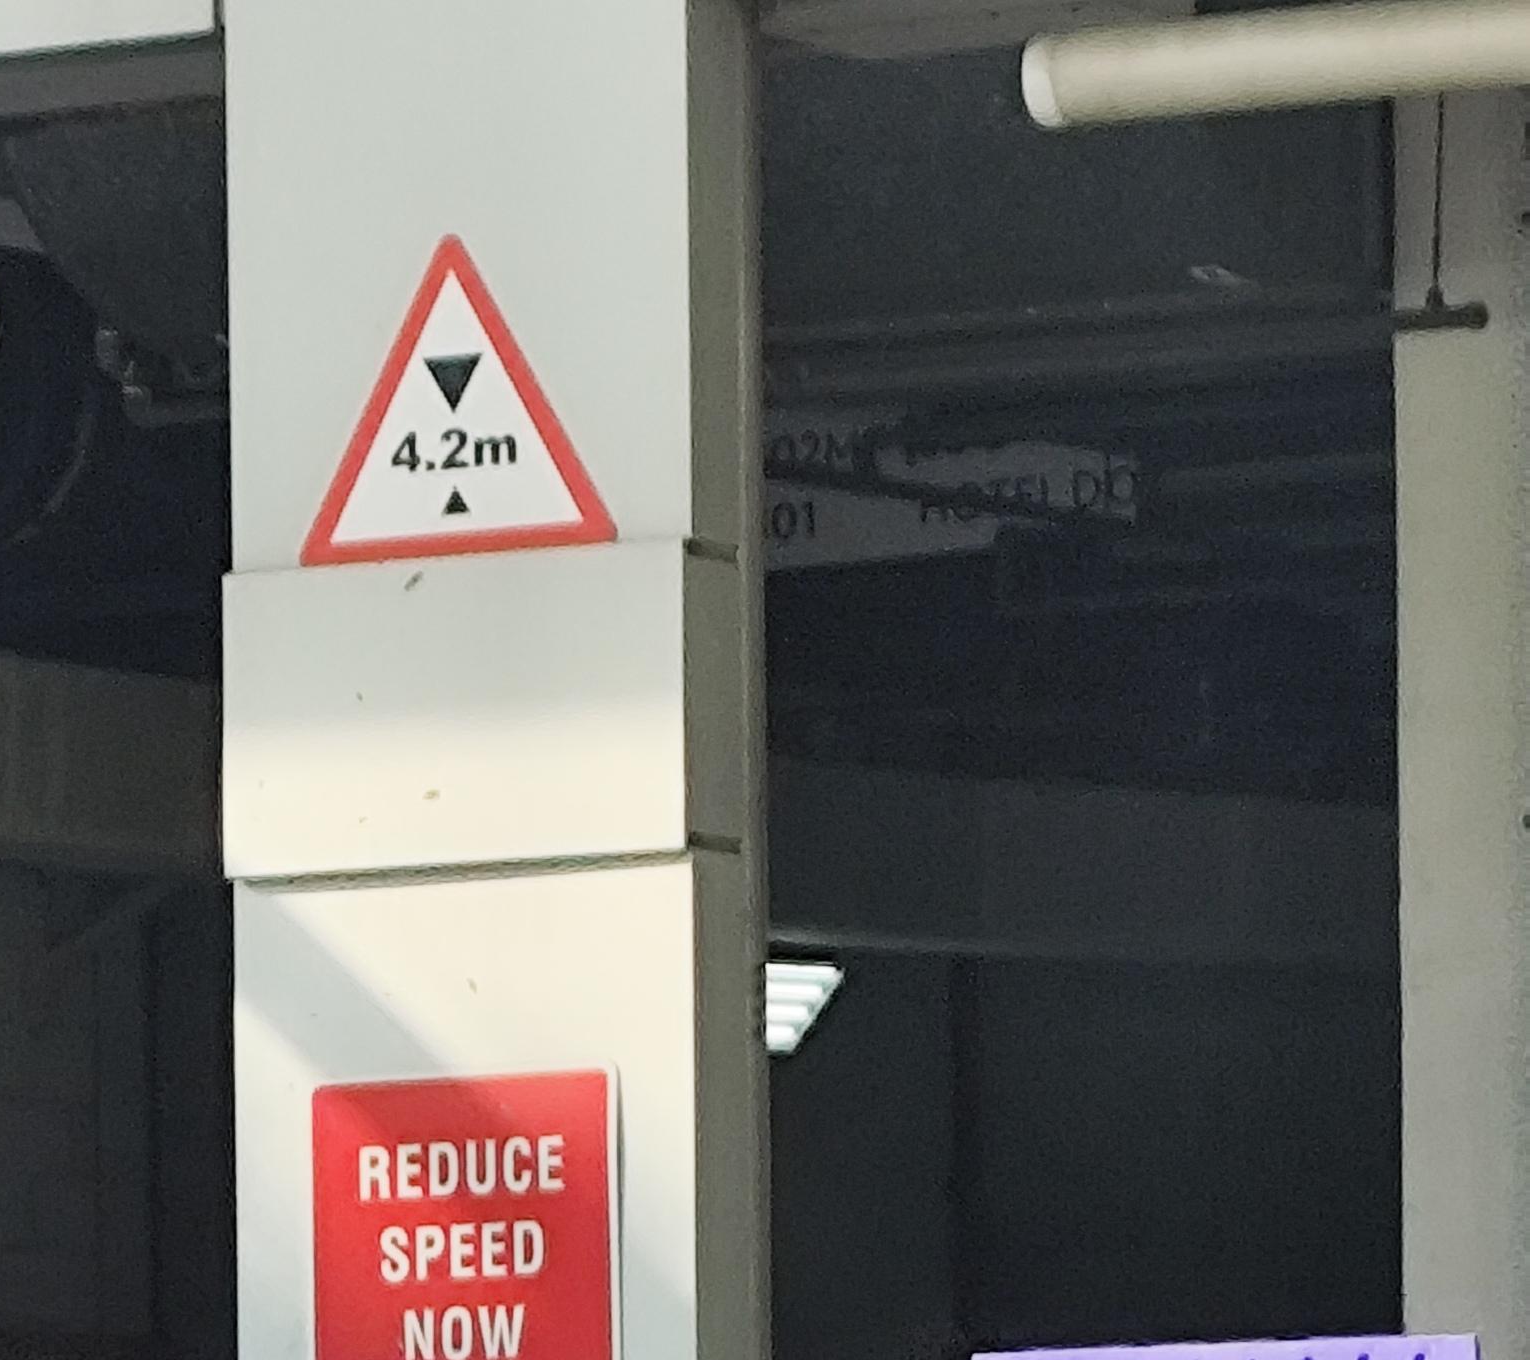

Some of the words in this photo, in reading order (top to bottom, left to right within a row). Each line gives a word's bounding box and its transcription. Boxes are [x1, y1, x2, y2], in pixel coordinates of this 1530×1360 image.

[390, 427, 518, 472] 4.2m
[358, 1134, 566, 1201] REDUCE
[379, 1219, 546, 1283] SPEED
